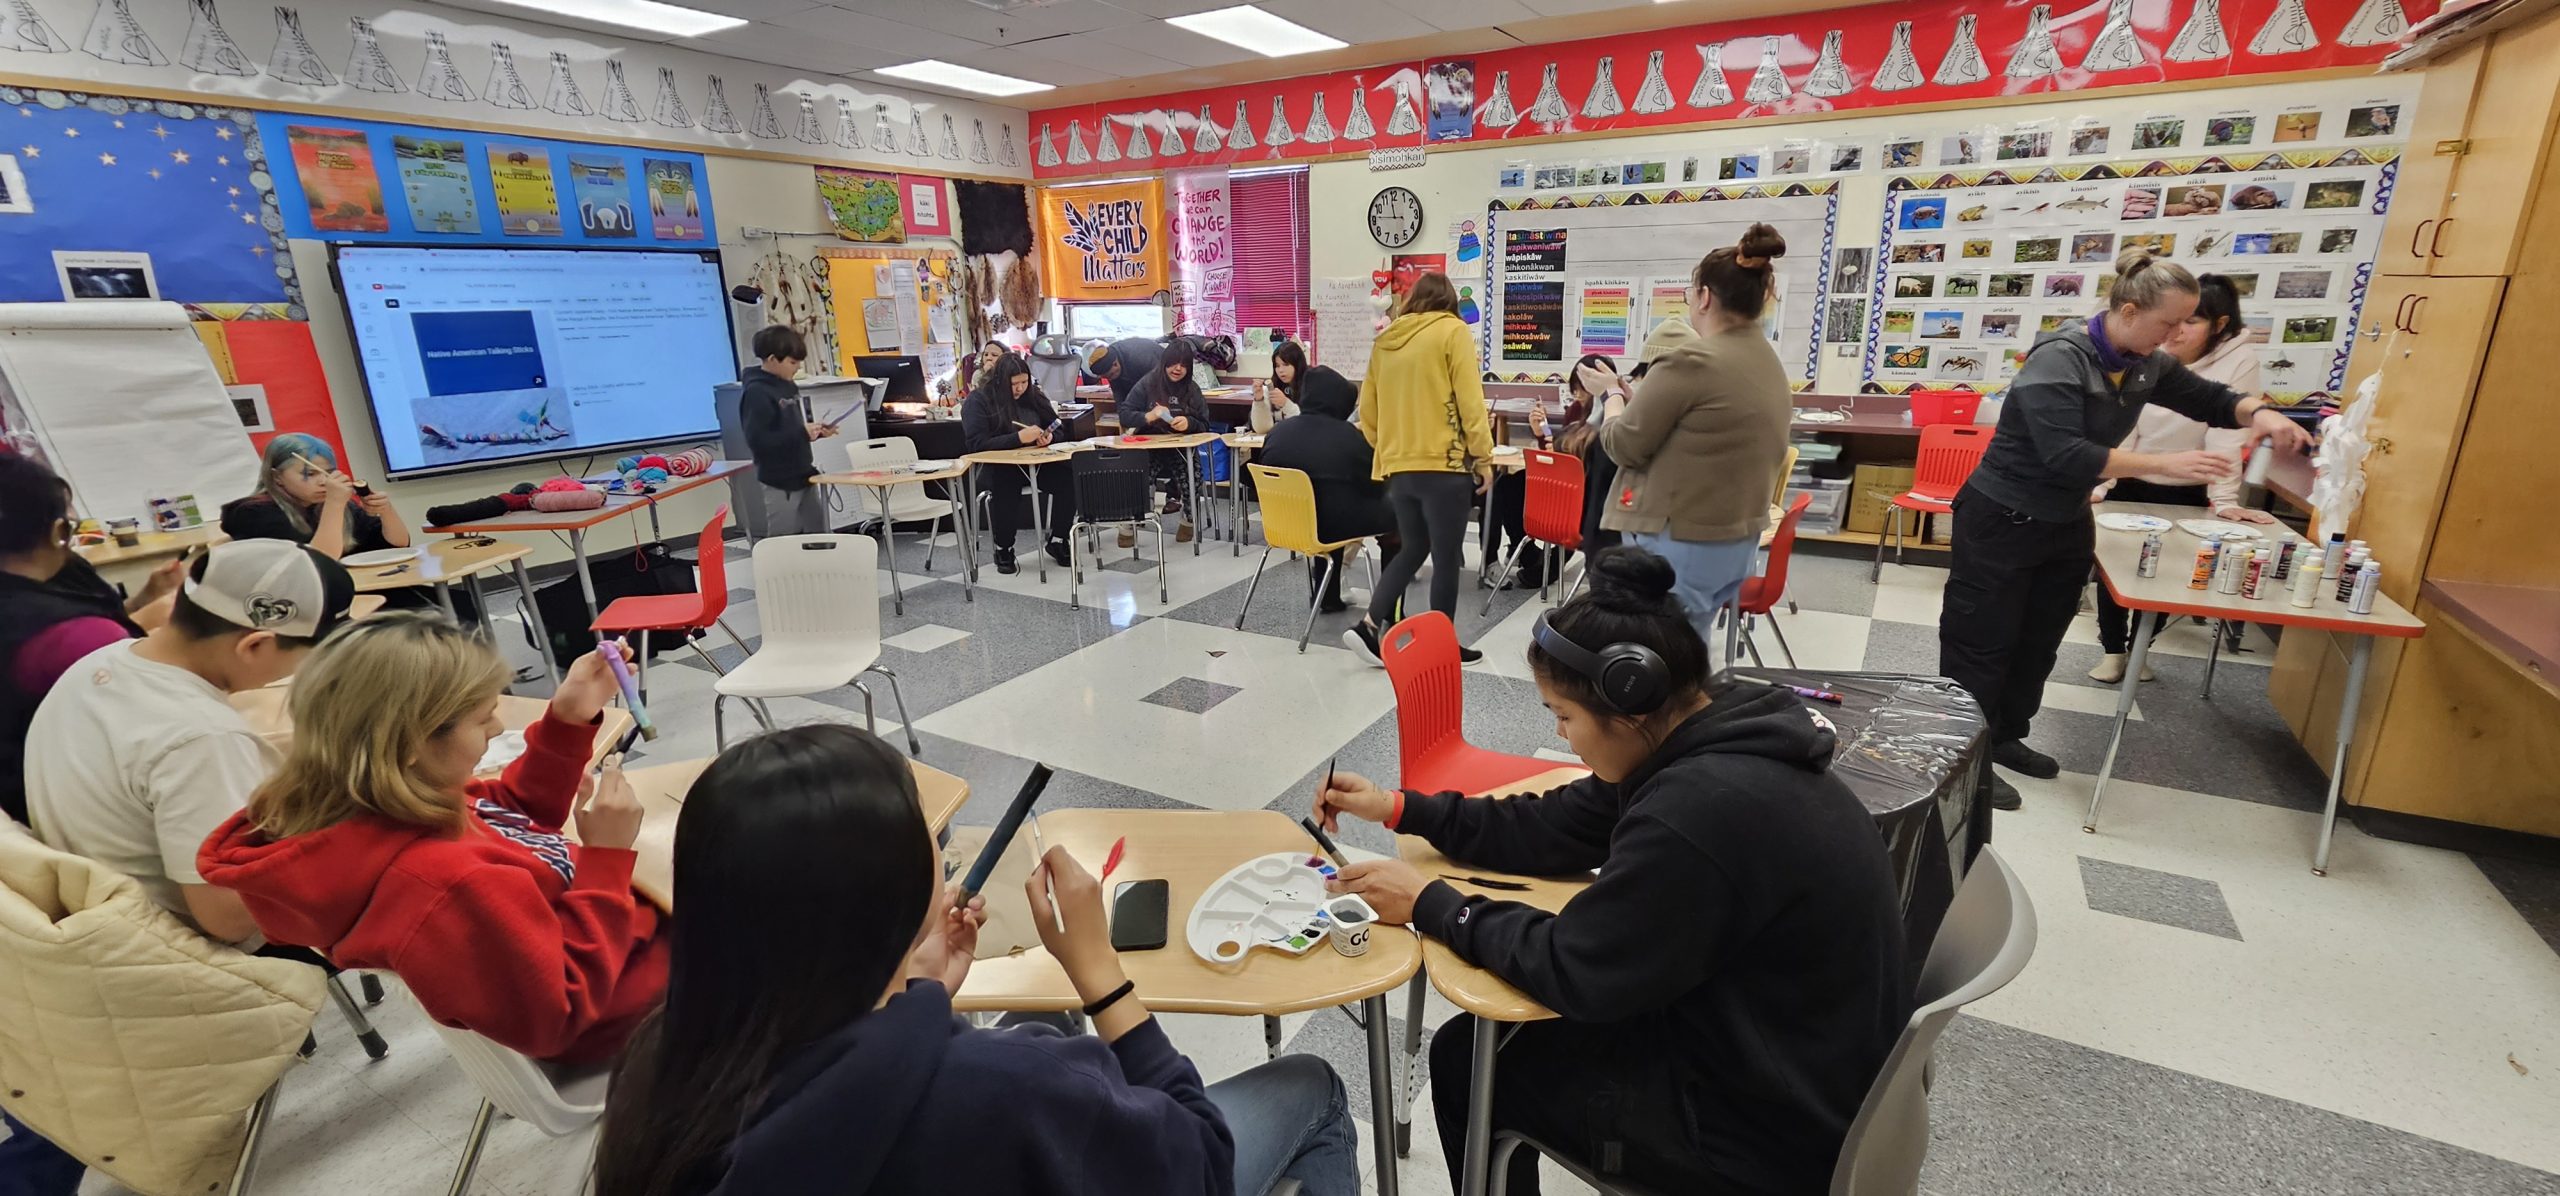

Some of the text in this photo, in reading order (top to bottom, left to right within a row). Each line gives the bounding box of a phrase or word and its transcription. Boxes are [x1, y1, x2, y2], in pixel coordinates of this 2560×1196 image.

[1173, 189, 1221, 203] TOGETHER
[1381, 194, 1389, 205] 11
[1390, 190, 1398, 201] 12
[1402, 192, 1406, 203] 1
[1375, 203, 1382, 214] 10
[1408, 198, 1414, 209] 2
[1097, 200, 1143, 227] EVERY
[1195, 206, 1212, 214] can
[1413, 208, 1419, 220] 3
[1172, 216, 1225, 235] CHANGE
[1372, 215, 1377, 226] 9
[1409, 221, 1415, 231] 4
[1376, 226, 1382, 237] 8
[1403, 230, 1408, 241] 5
[1103, 224, 1148, 255] CHILD
[1192, 235, 1206, 245] the
[1385, 232, 1390, 243] 7
[1394, 233, 1399, 244] 6
[1175, 236, 1224, 264] WORLD!
[1084, 254, 1146, 282] Matters
[427, 346, 535, 358] Native American Talking Sticks
